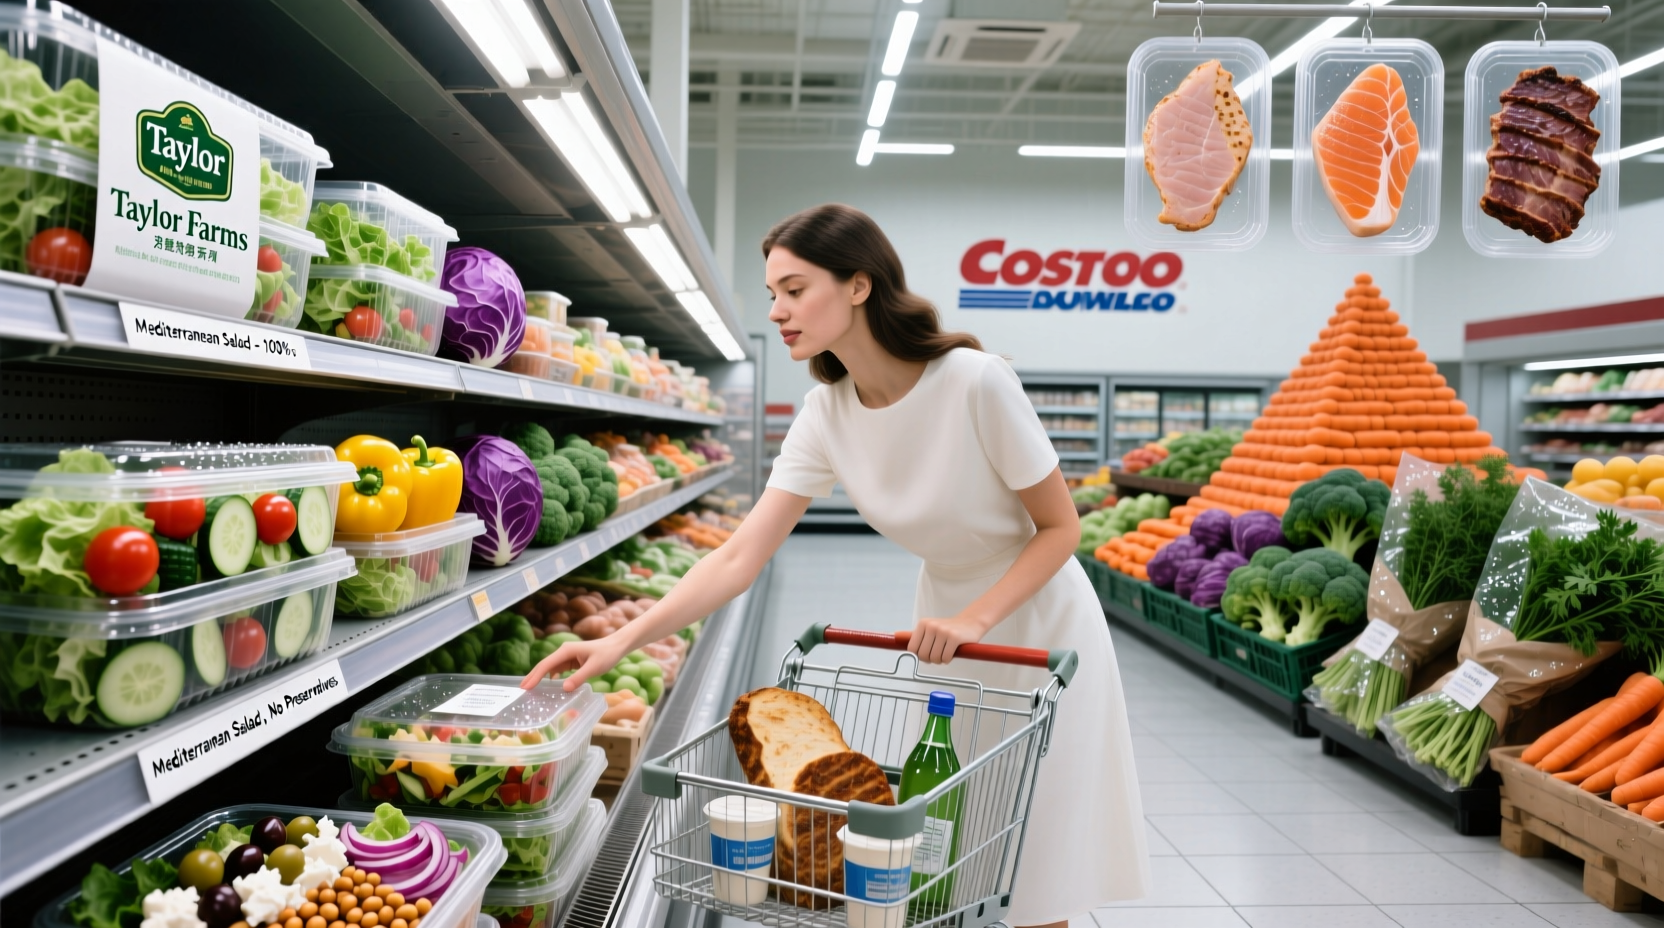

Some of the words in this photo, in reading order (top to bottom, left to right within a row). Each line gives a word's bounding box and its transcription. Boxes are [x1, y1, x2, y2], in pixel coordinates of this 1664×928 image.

[146, 121, 226, 176] Taylor
[110, 187, 183, 232] Taylor
[186, 209, 248, 251] Farms
[222, 332, 251, 350] Salad
[267, 701, 284, 720] No
